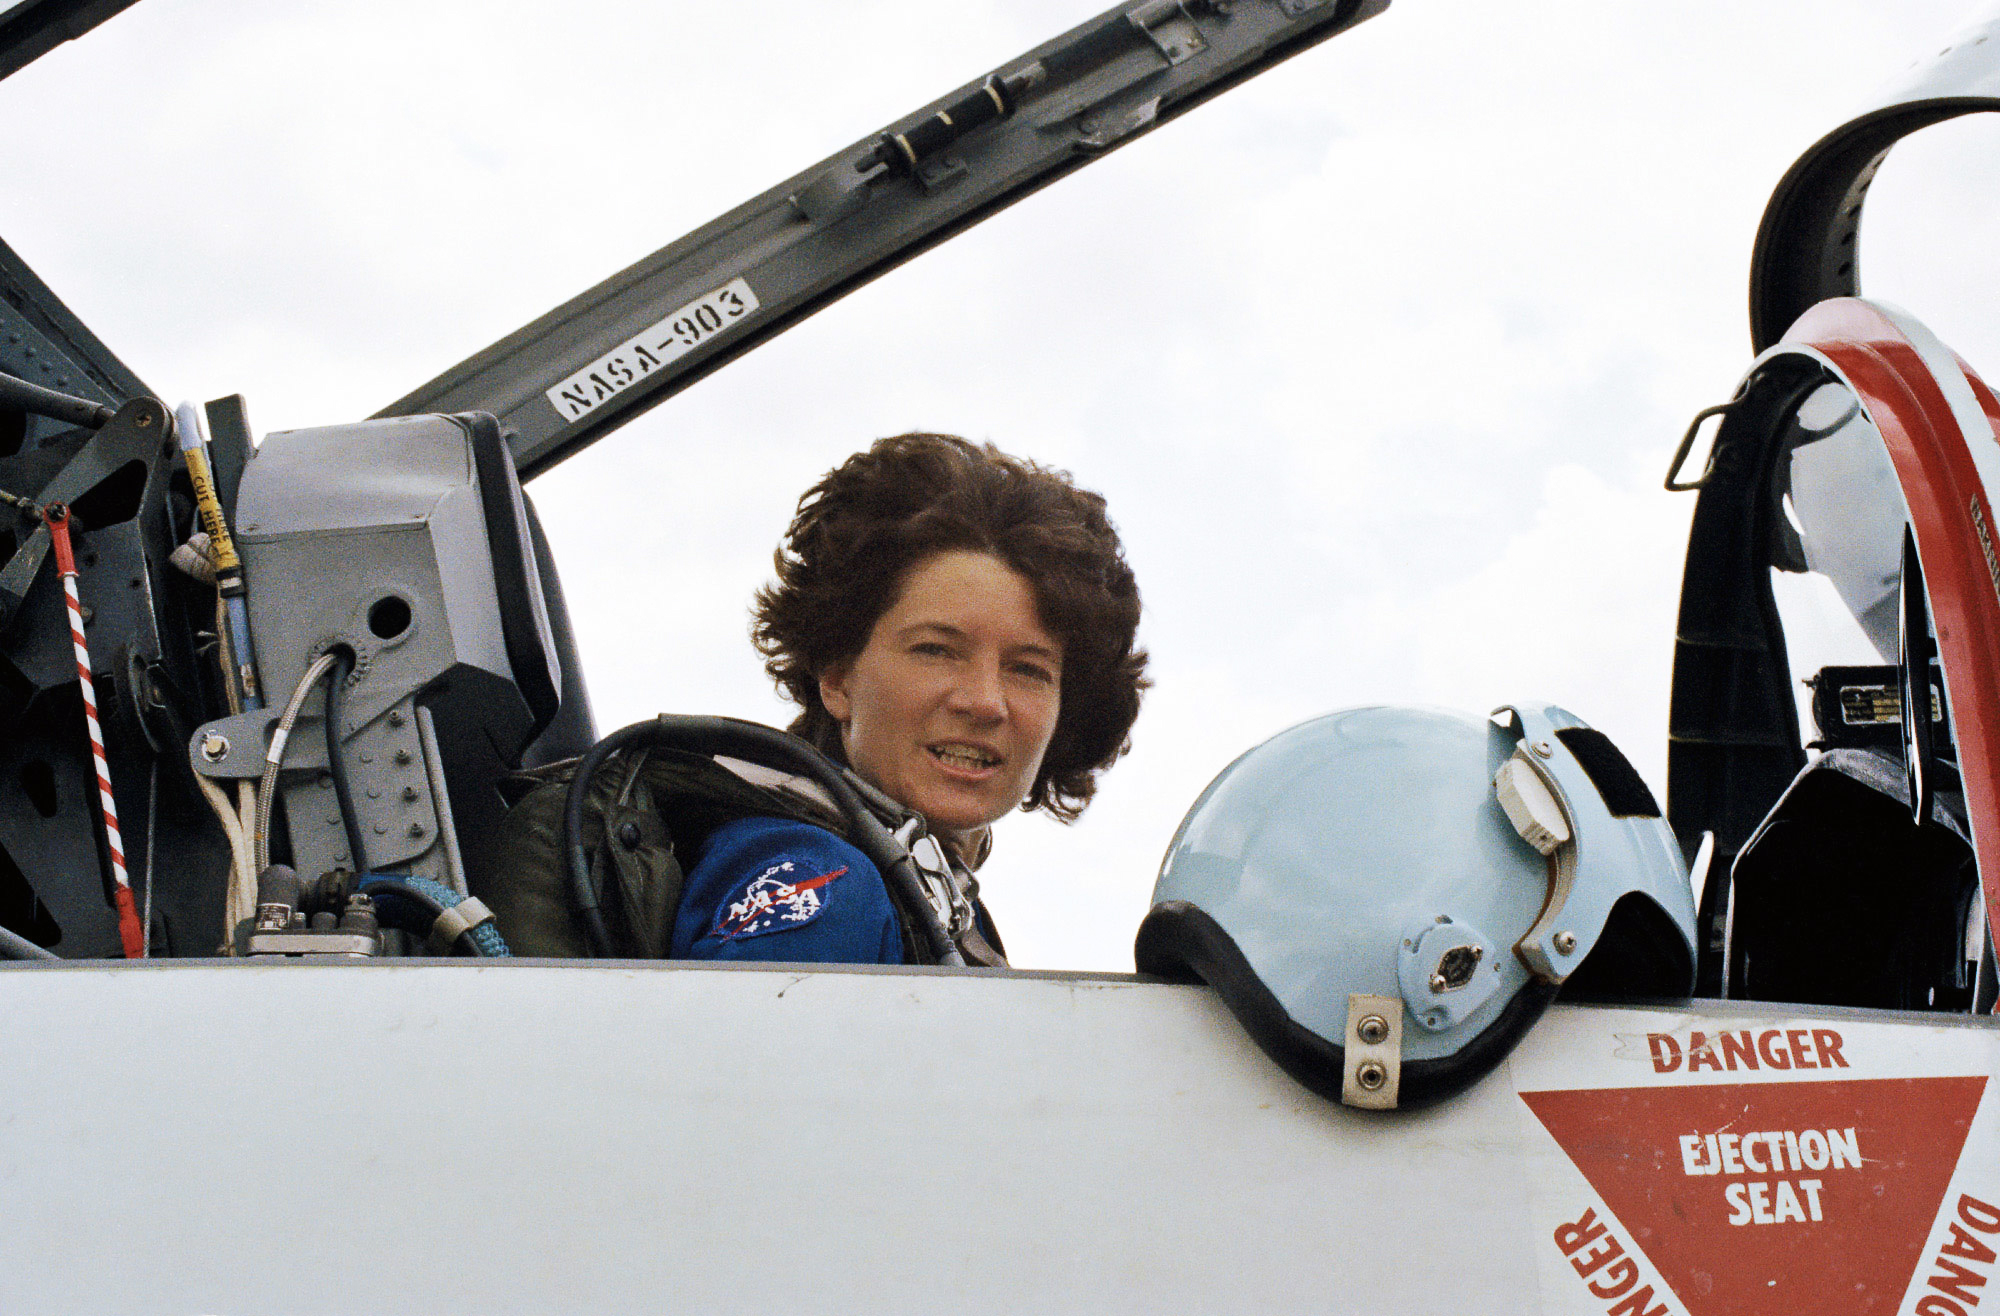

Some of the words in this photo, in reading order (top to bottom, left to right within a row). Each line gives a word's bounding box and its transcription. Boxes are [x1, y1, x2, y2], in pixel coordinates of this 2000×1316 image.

[561, 290, 744, 415] NASA-903
[194, 476, 210, 502] CUT
[203, 510, 221, 543] HERE
[728, 884, 821, 923] NASA
[1647, 1029, 1851, 1073] DANGER
[1678, 1127, 1863, 1176] EJECTION
[1725, 1179, 1823, 1227] SEAT
